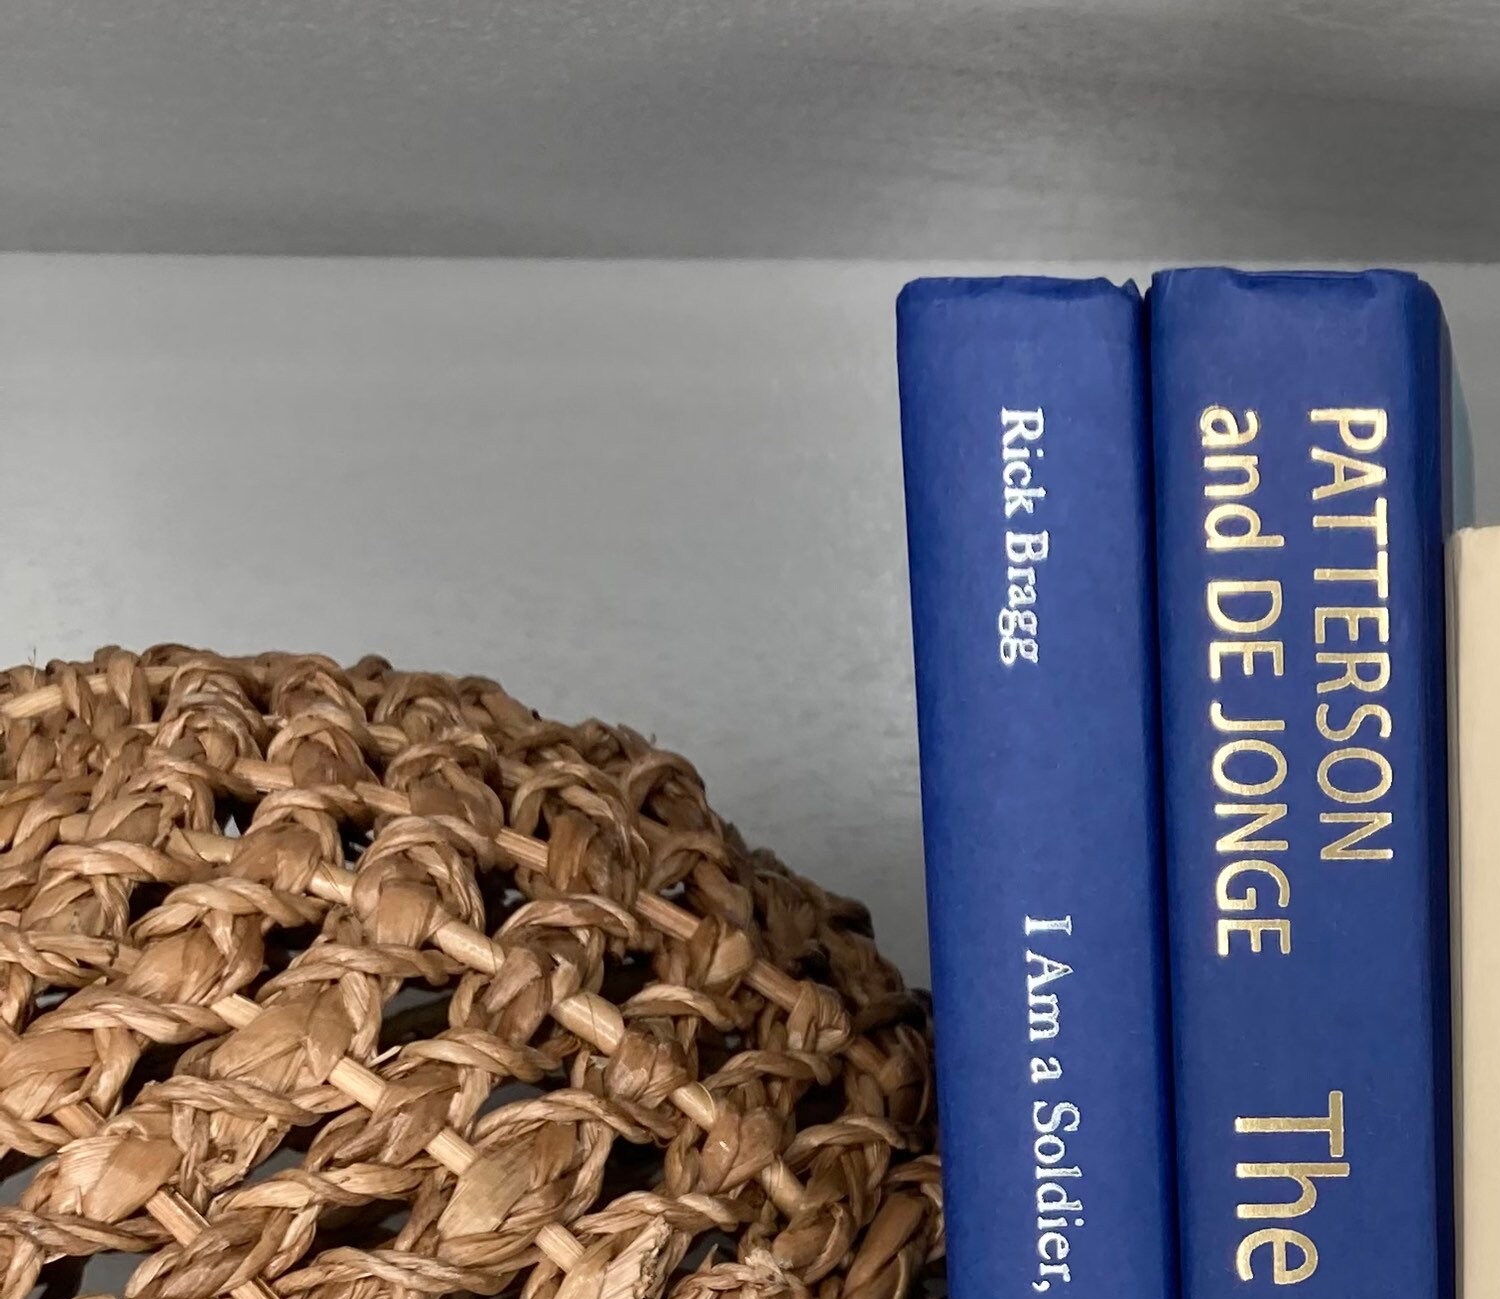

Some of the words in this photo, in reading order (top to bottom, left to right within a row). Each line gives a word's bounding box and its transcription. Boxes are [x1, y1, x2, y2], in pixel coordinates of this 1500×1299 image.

[1000, 406, 1047, 518] Rick
[1200, 404, 1285, 551] and
[998, 529, 1050, 667] Bragg
[1206, 579, 1284, 681] DE
[1309, 407, 1394, 861] PATTERSON
[1210, 700, 1292, 957] JONGE
[1025, 914, 1072, 937] I
[1025, 950, 1074, 1042] Am
[1030, 1056, 1063, 1083] a
[1031, 1101, 1086, 1293] Soldier,
[1234, 1089, 1351, 1285] The
